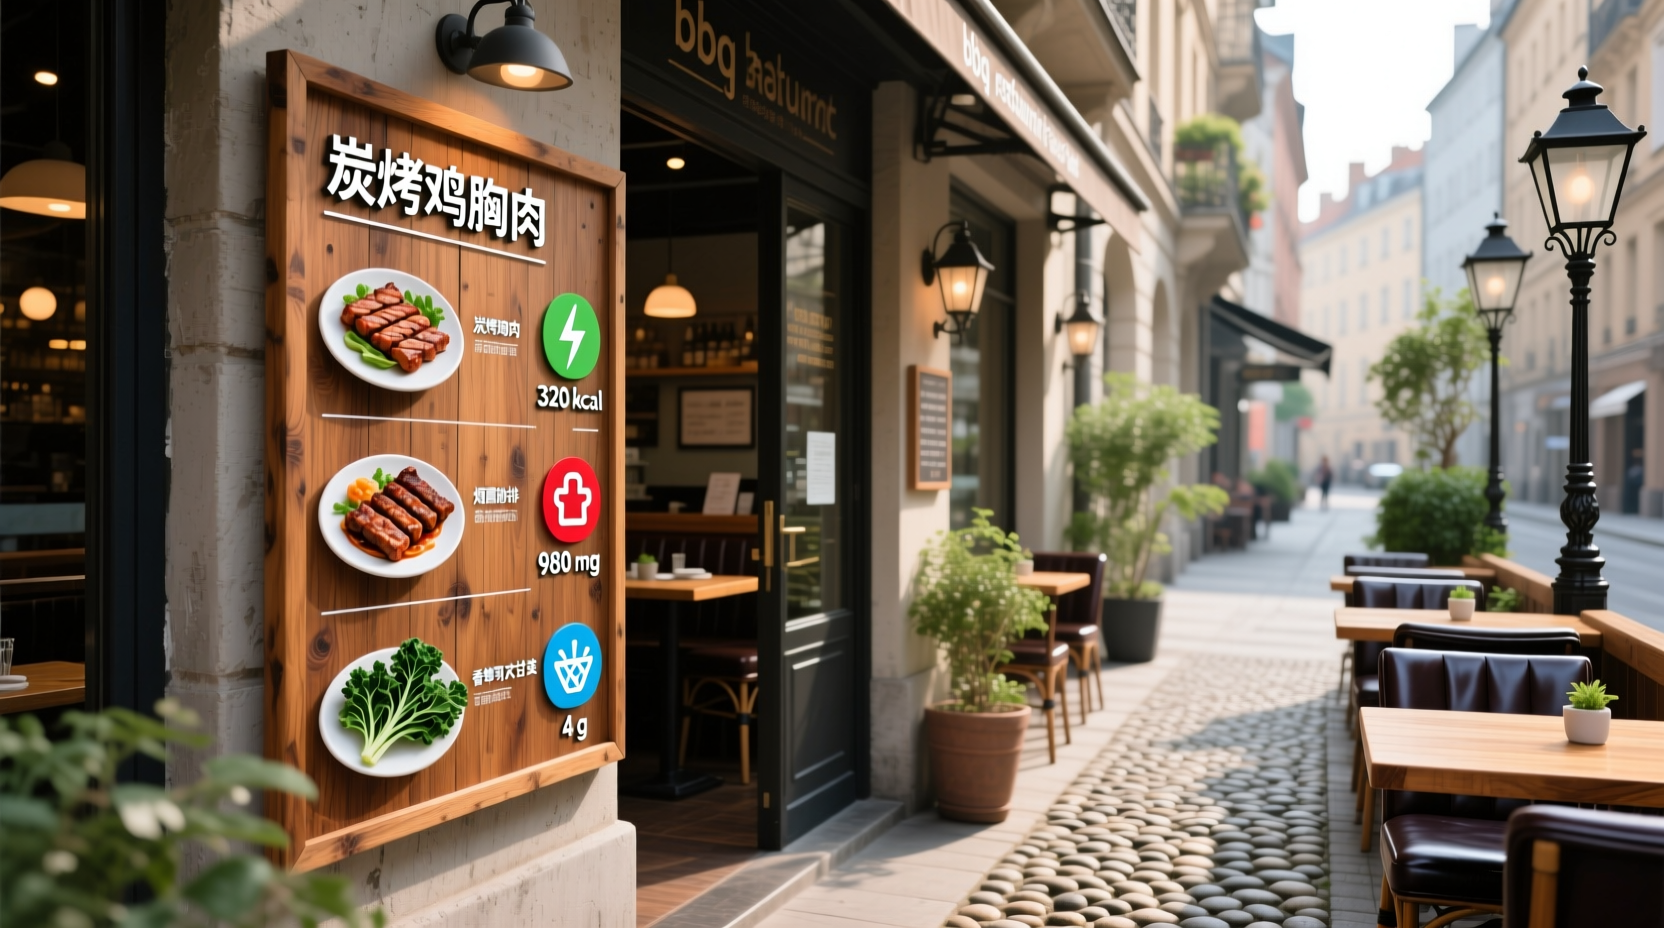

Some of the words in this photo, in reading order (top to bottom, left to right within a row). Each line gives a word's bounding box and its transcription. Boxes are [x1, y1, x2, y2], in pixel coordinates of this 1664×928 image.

[326, 133, 546, 248] 炭烤鸡胸肉
[537, 384, 570, 409] 320
[572, 386, 603, 411] kcal
[538, 550, 572, 576] 980
[575, 553, 600, 577] mg
[562, 714, 574, 737] 4
[576, 717, 588, 742] g
